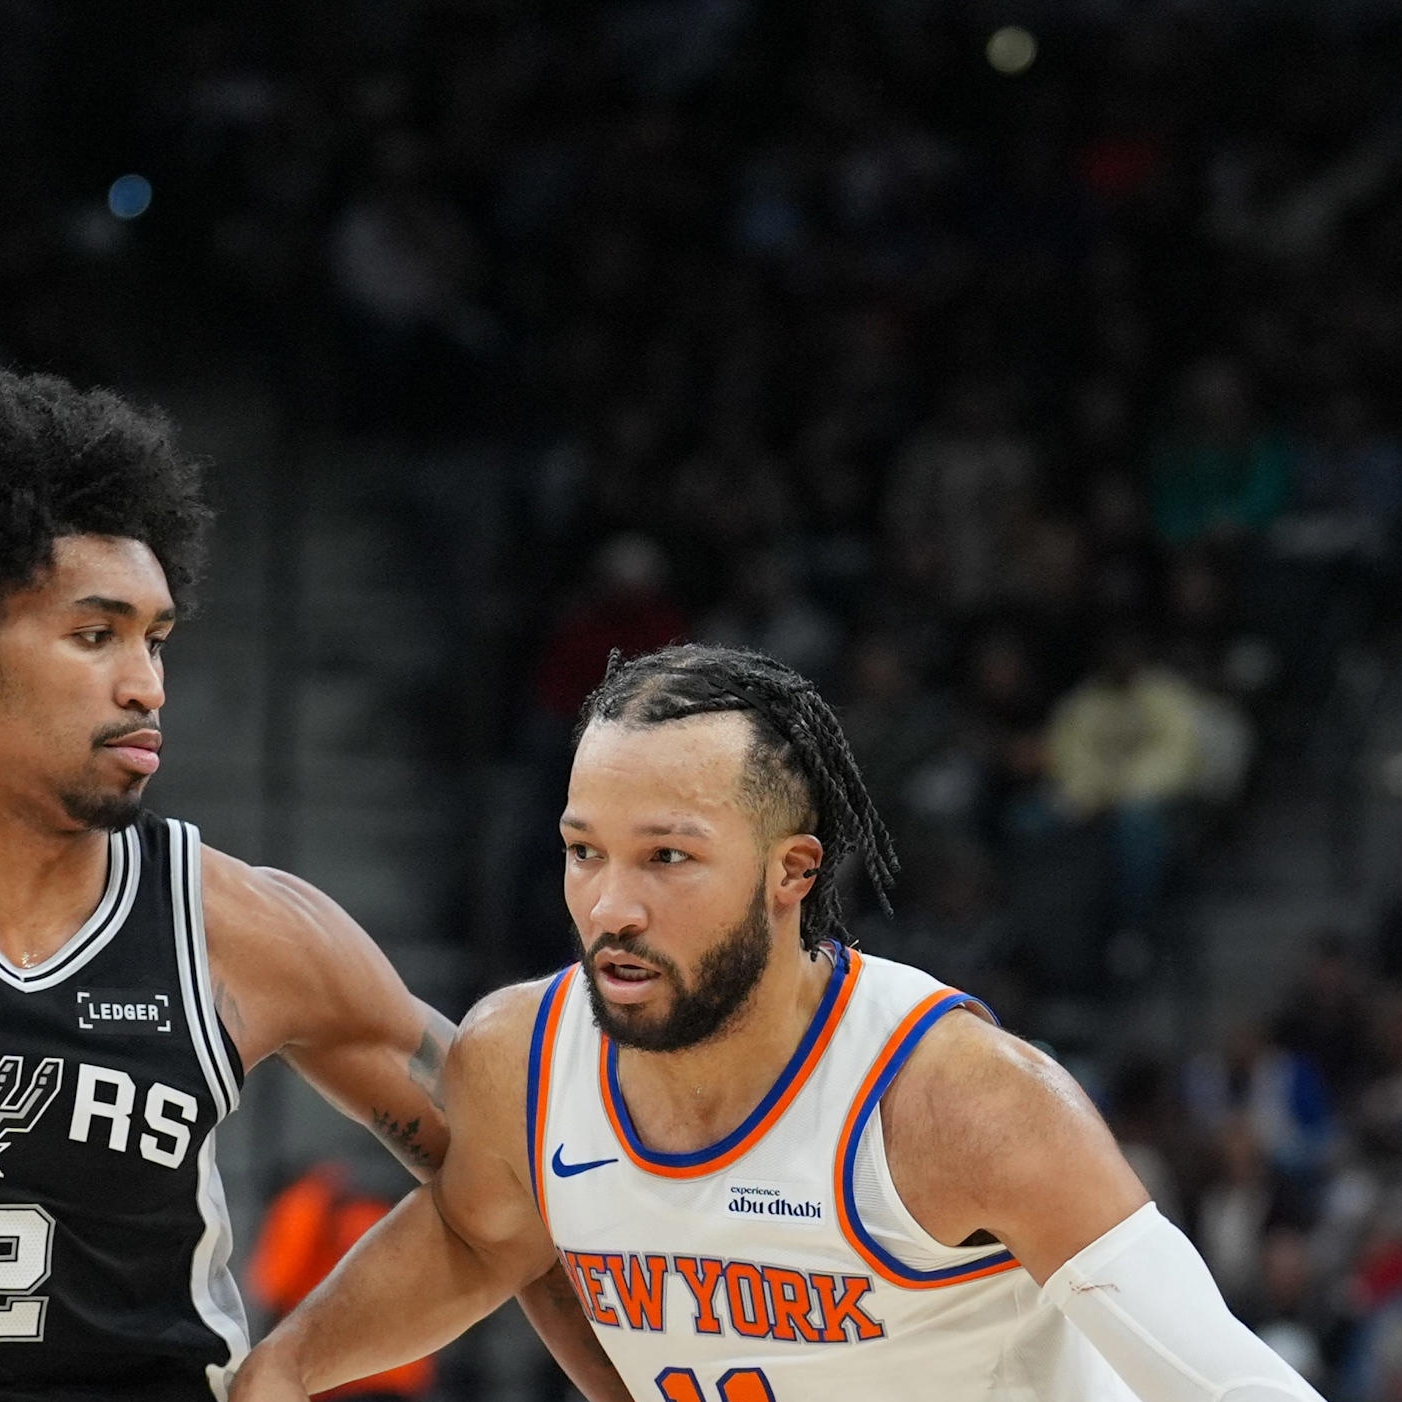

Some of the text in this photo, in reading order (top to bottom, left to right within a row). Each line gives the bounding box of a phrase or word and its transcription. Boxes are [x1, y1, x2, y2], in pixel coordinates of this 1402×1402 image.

[88, 1002, 159, 1021] LEDGER
[730, 1185, 780, 1196] experience
[728, 1196, 821, 1218] abu dhabi
[673, 1254, 887, 1344] YORK
